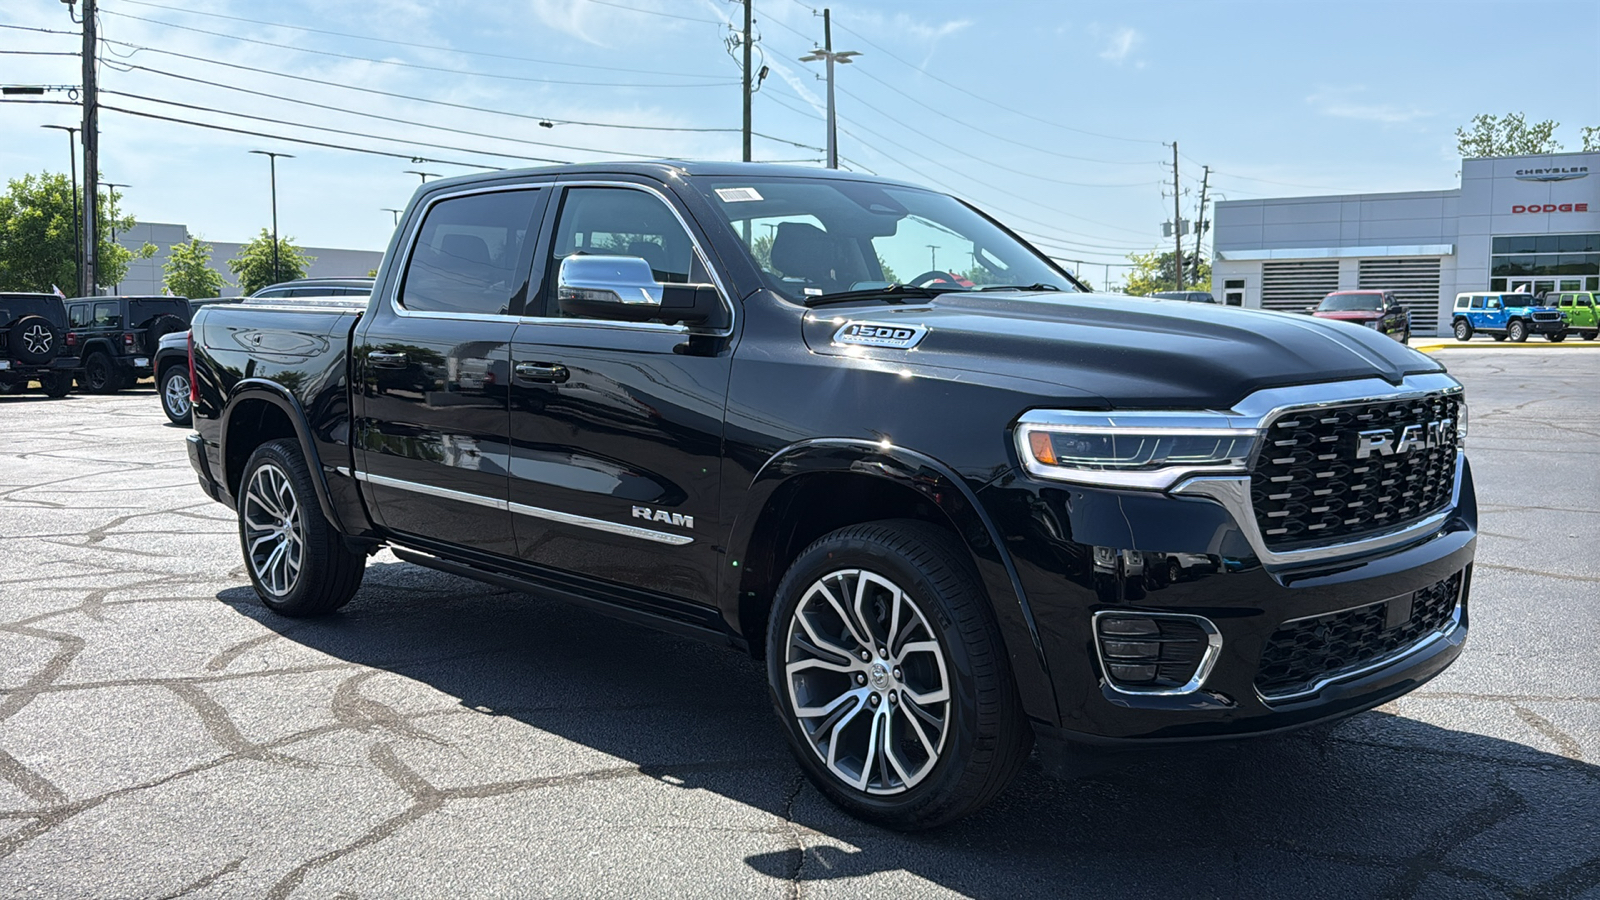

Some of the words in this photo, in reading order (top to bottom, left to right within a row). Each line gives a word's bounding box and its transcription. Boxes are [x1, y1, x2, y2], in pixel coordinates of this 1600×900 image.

[1515, 166, 1588, 175] CHRYSLER
[1512, 203, 1588, 214] DODGE
[851, 325, 911, 339] 1500
[1356, 418, 1451, 459] RAM
[631, 505, 694, 529] RAM
